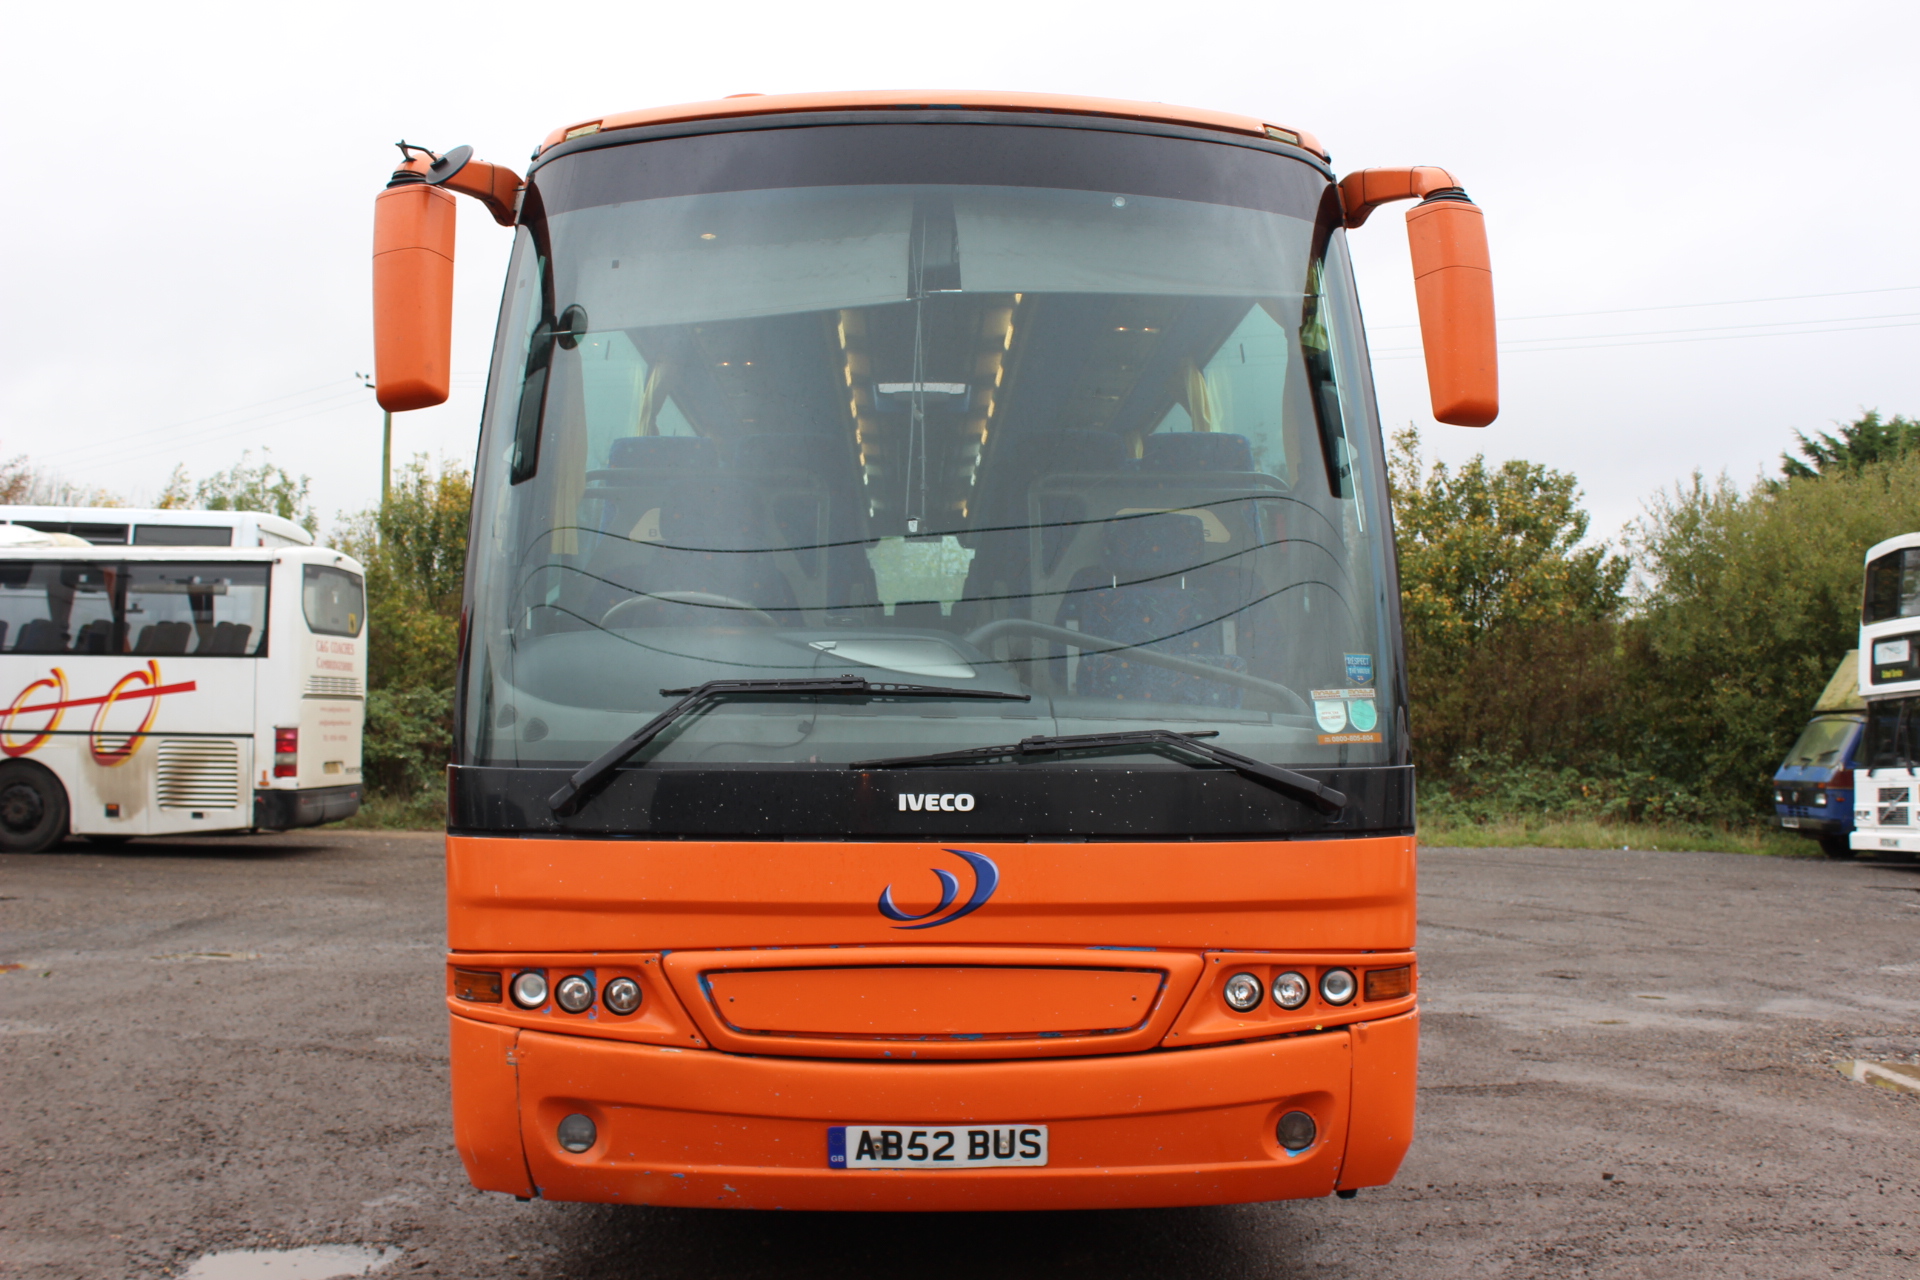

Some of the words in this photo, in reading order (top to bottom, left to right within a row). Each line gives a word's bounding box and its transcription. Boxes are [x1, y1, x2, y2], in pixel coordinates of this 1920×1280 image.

[331, 641, 355, 655] COACHES
[1347, 657, 1369, 665] RESPECT
[898, 793, 975, 812] IVECO
[855, 1130, 955, 1161] AB52
[968, 1129, 1041, 1160] BUS
[830, 1154, 845, 1163] GB
